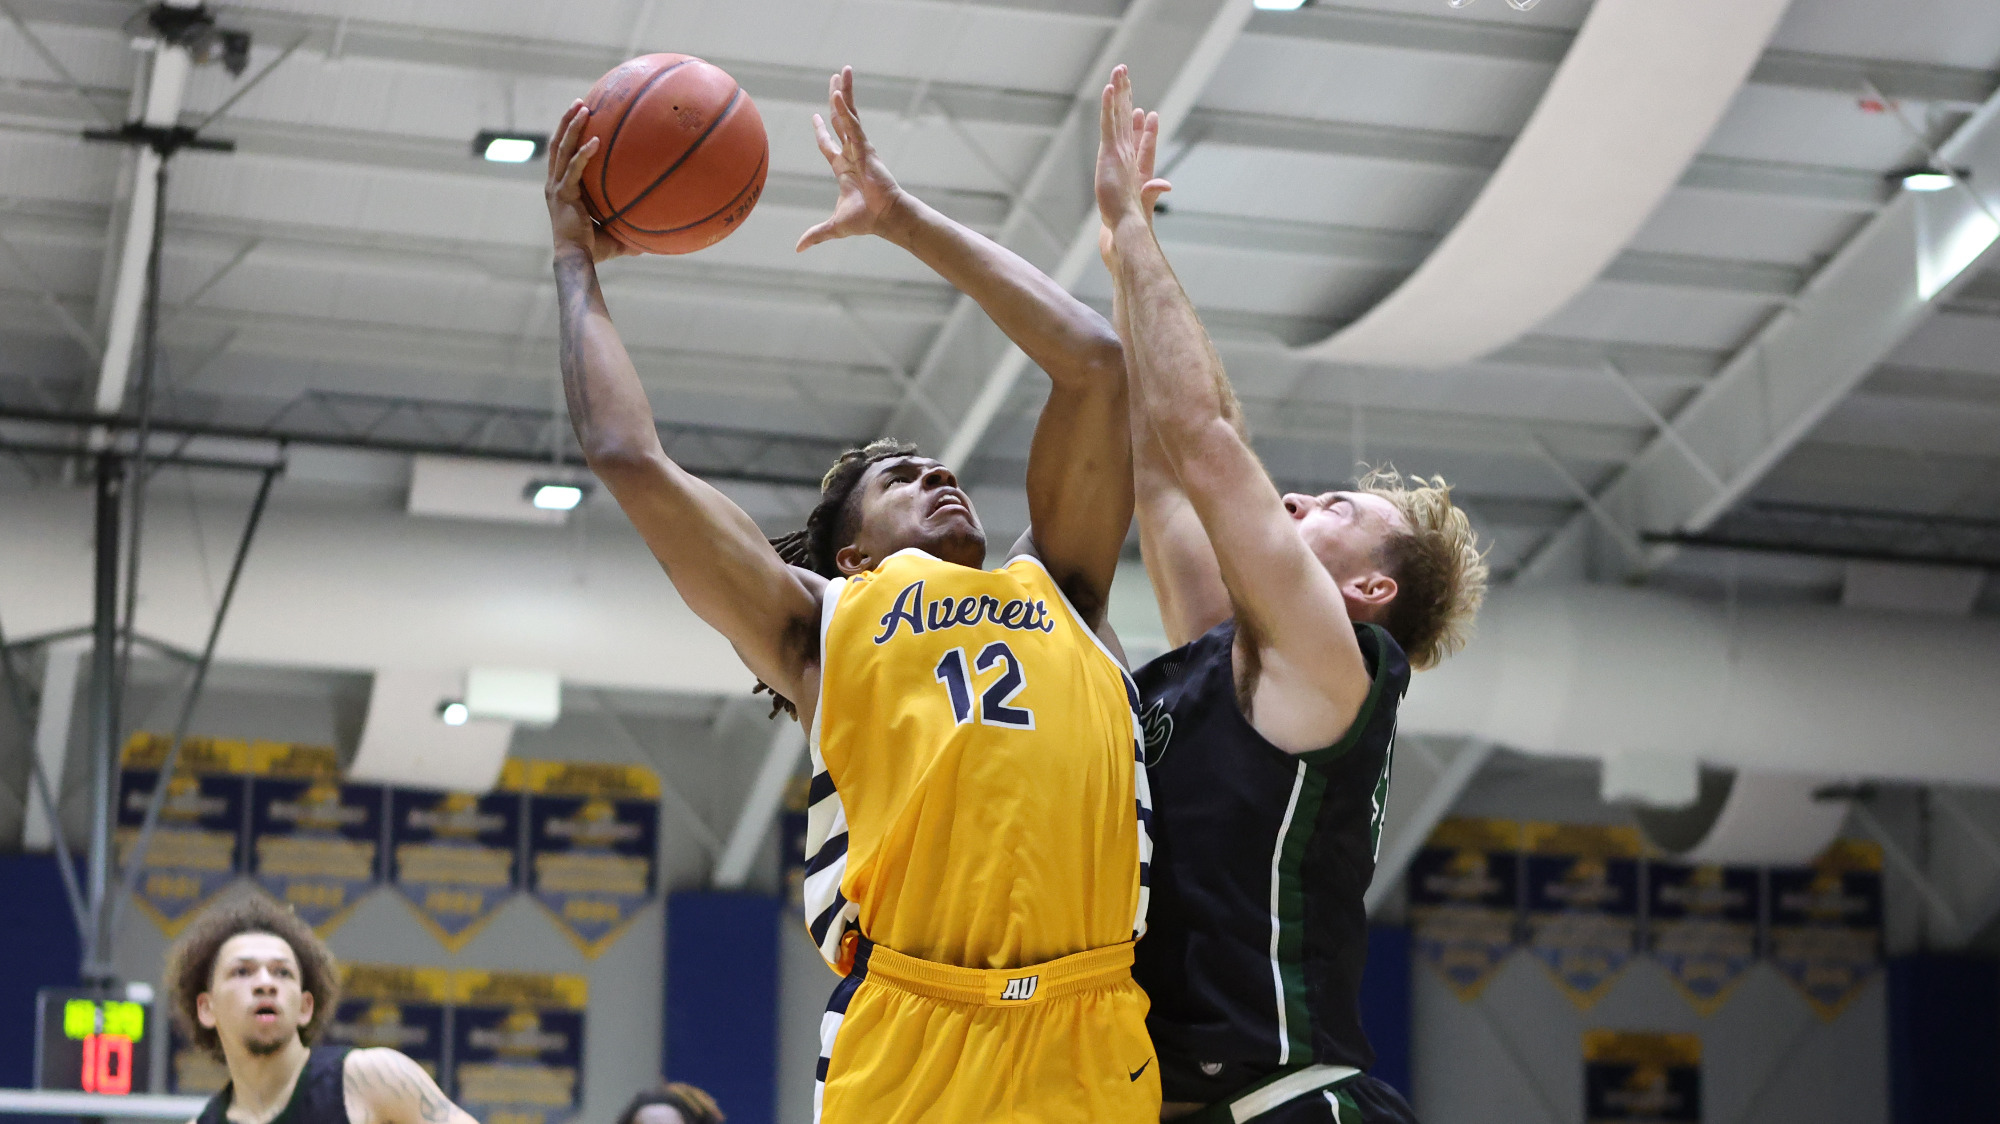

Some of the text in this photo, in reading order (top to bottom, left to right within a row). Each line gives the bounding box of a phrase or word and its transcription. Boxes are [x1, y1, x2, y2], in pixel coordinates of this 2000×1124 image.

[873, 580, 1055, 645] Averett
[933, 640, 1036, 730] 12
[1000, 974, 1039, 1001] AU
[81, 1033, 133, 1095] 10
